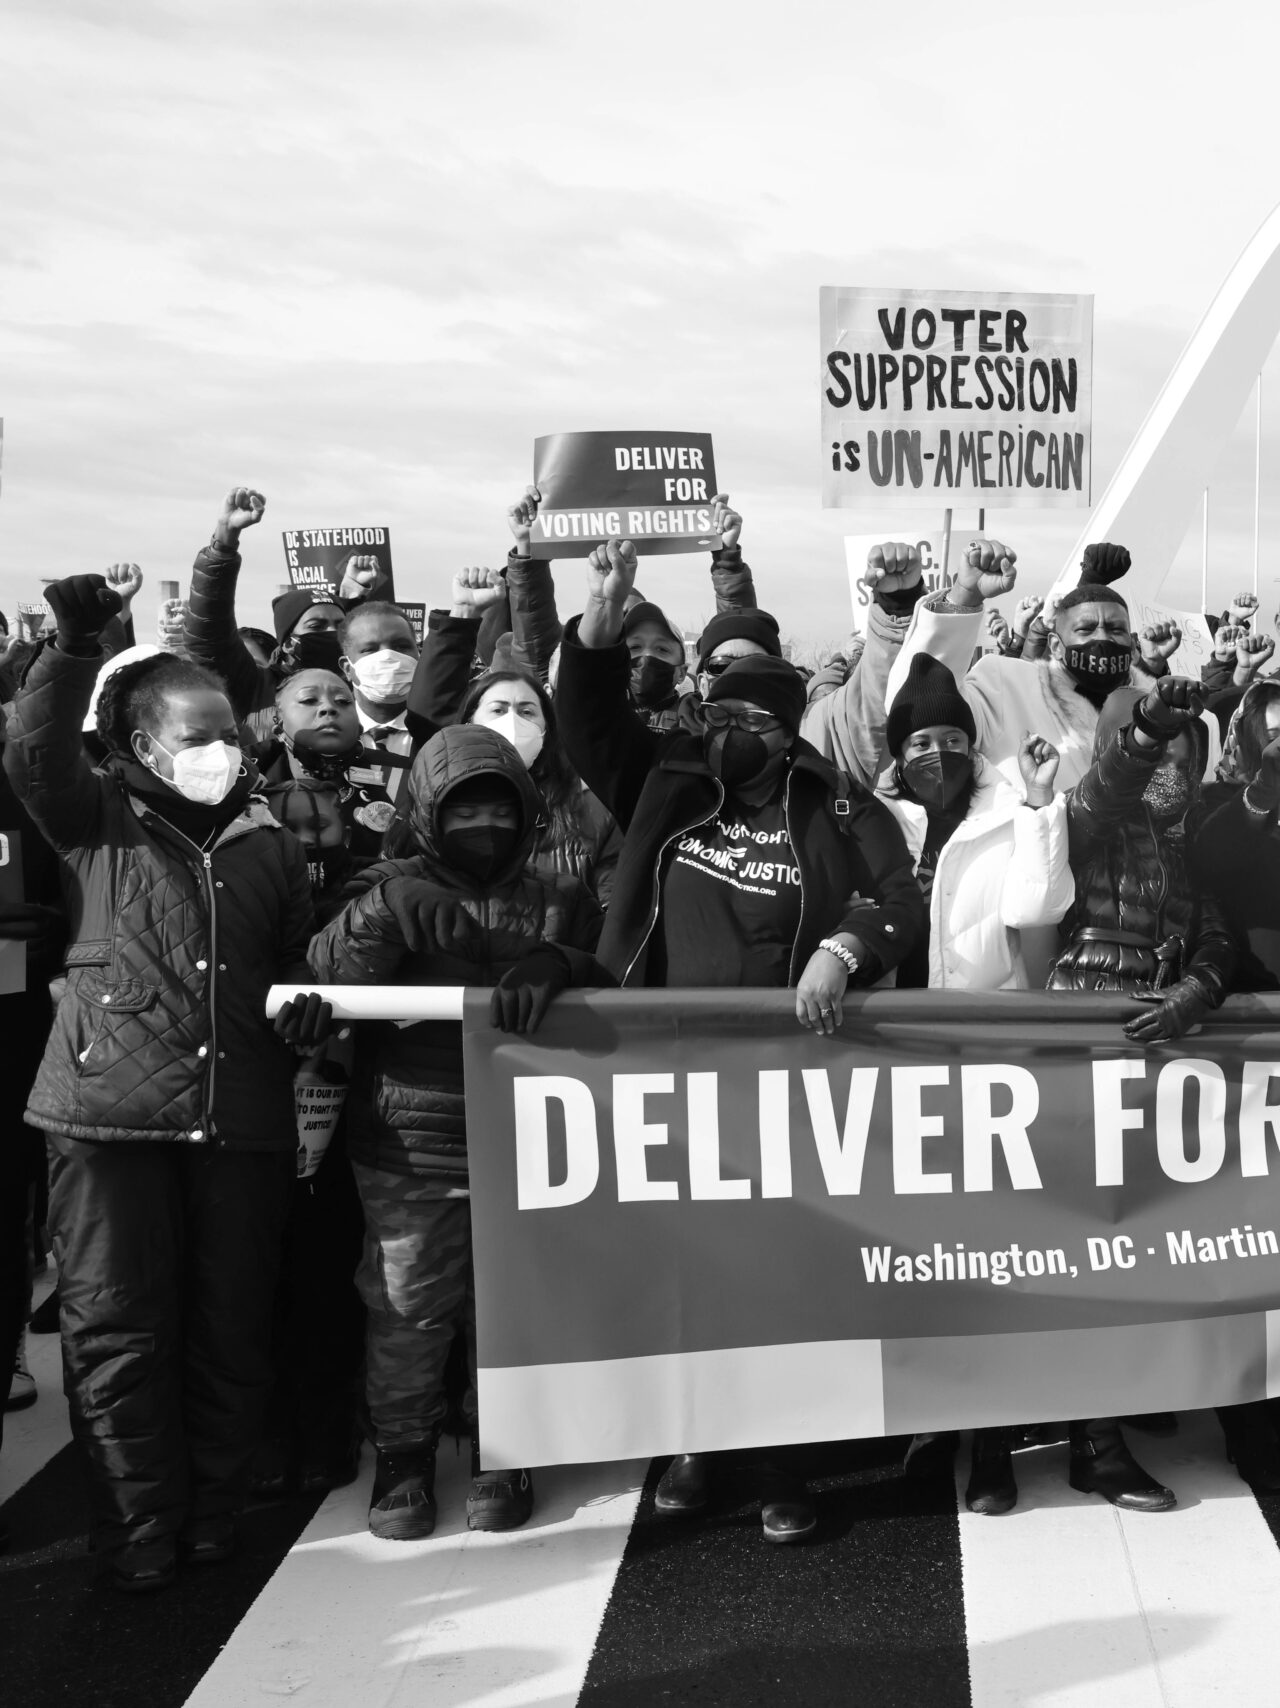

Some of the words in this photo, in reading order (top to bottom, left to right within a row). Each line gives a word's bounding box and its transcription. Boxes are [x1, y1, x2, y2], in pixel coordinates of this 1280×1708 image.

[878, 307, 1029, 353] VOTER
[825, 351, 1077, 414] SUPPRESSION
[615, 447, 704, 471] DELIVER
[832, 441, 861, 472] is
[664, 478, 708, 501] FOR
[539, 511, 621, 537] VOTING
[628, 509, 711, 534] RIGHTS
[286, 531, 300, 549] DC
[303, 528, 385, 547] STATEHOOD
[288, 549, 299, 567] IS
[291, 565, 328, 585] RACIAL
[1071, 650, 1130, 675] BLESSED
[739, 861, 801, 886] JUSTIC
[316, 1088, 332, 1099] OUR
[310, 1104, 331, 1115] FIGHT
[514, 1063, 1044, 1211] DELIVER
[860, 1241, 1078, 1286] Washington,
[1087, 1235, 1137, 1272] DC
[1166, 1221, 1280, 1266] Martin
